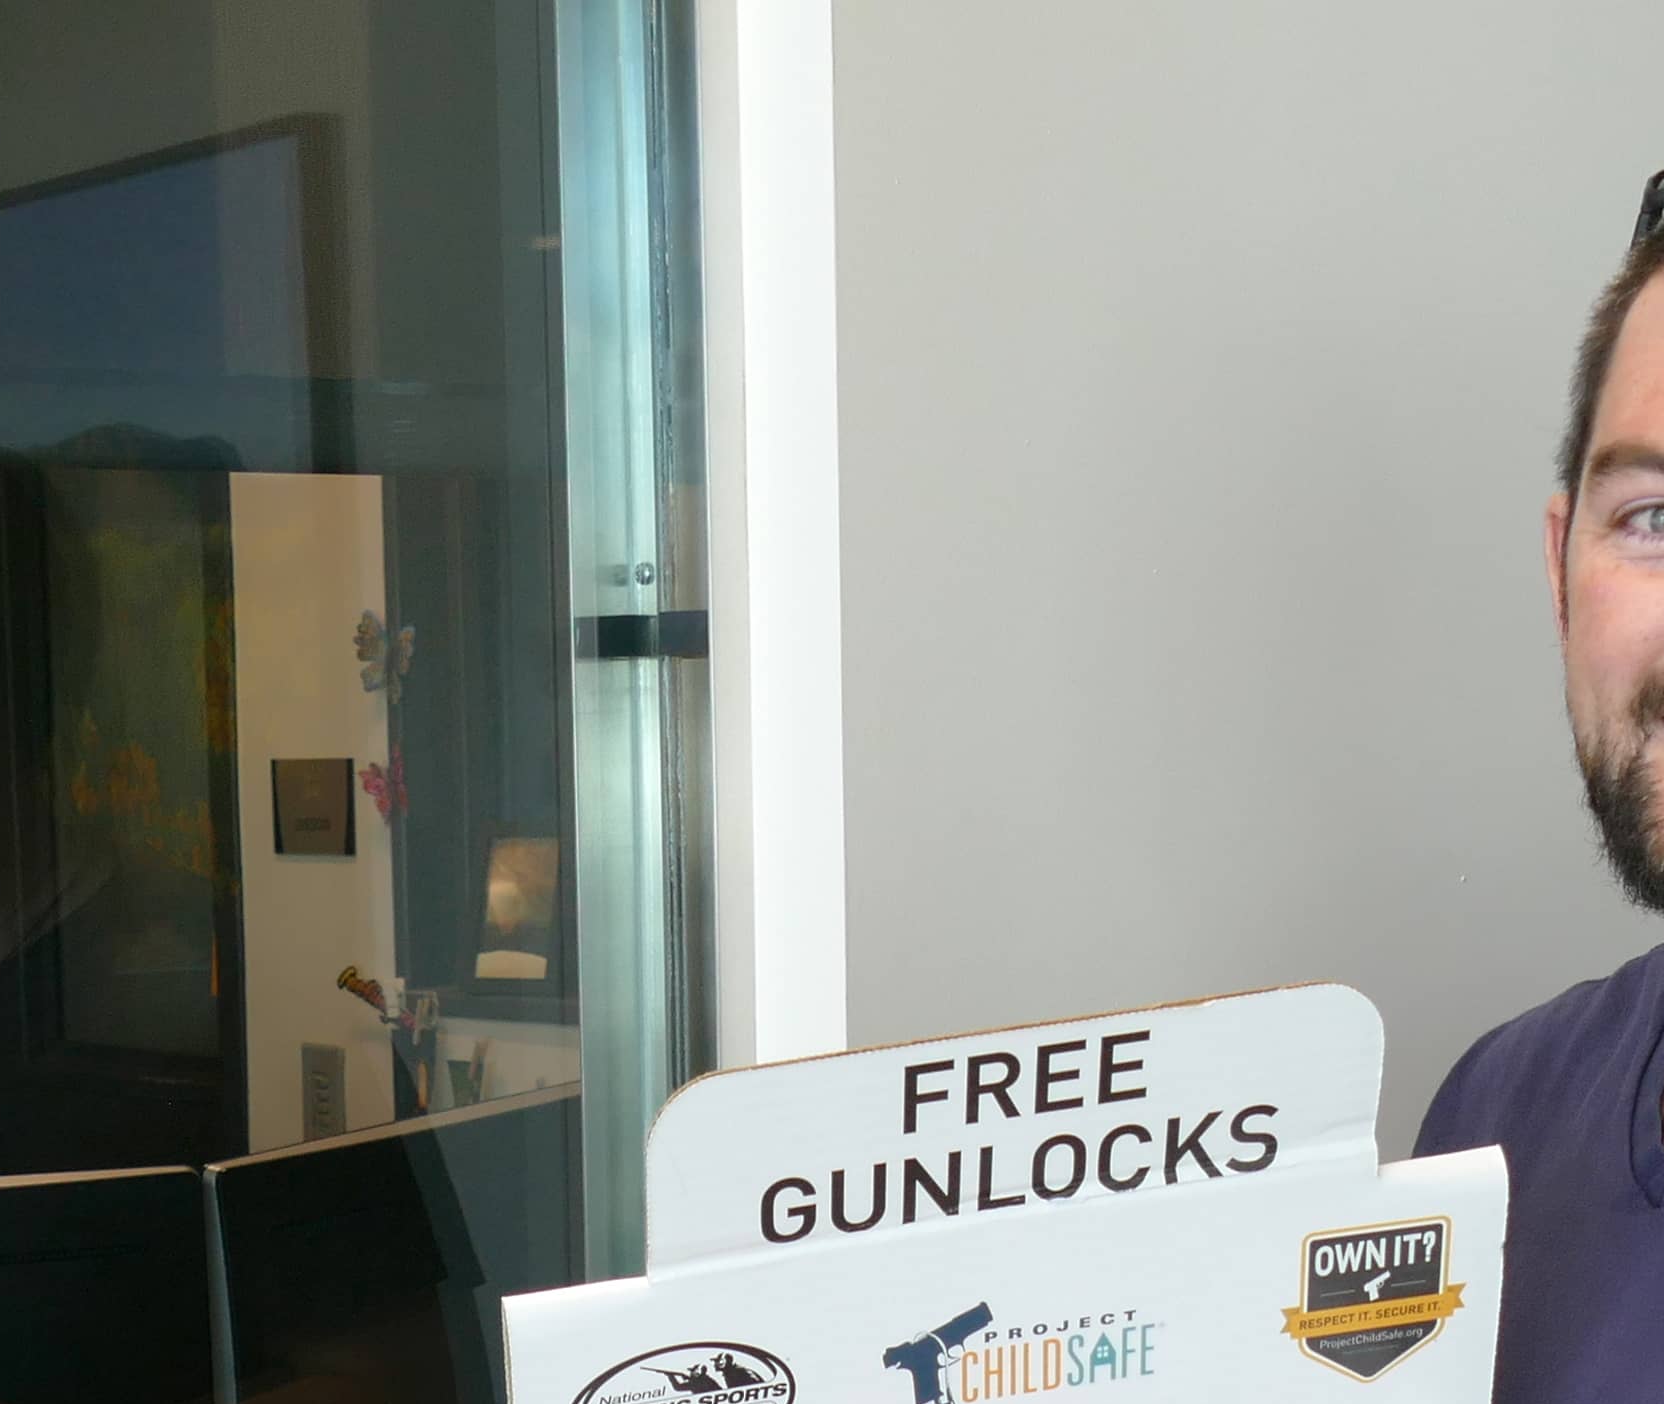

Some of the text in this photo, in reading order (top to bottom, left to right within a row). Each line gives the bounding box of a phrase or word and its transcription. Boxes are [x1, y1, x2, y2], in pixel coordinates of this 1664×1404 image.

[900, 1029, 1152, 1134] FREE
[759, 1104, 1280, 1244] GUNLOCKS
[1314, 1230, 1436, 1277] OWN IT?
[984, 1309, 1137, 1343] PROJECT
[1299, 1300, 1441, 1331] RESPECT IT. SECURE IT.
[1319, 1326, 1424, 1350] ProjectChildSafe.org
[961, 1323, 1155, 1404] CHILDSAFE
